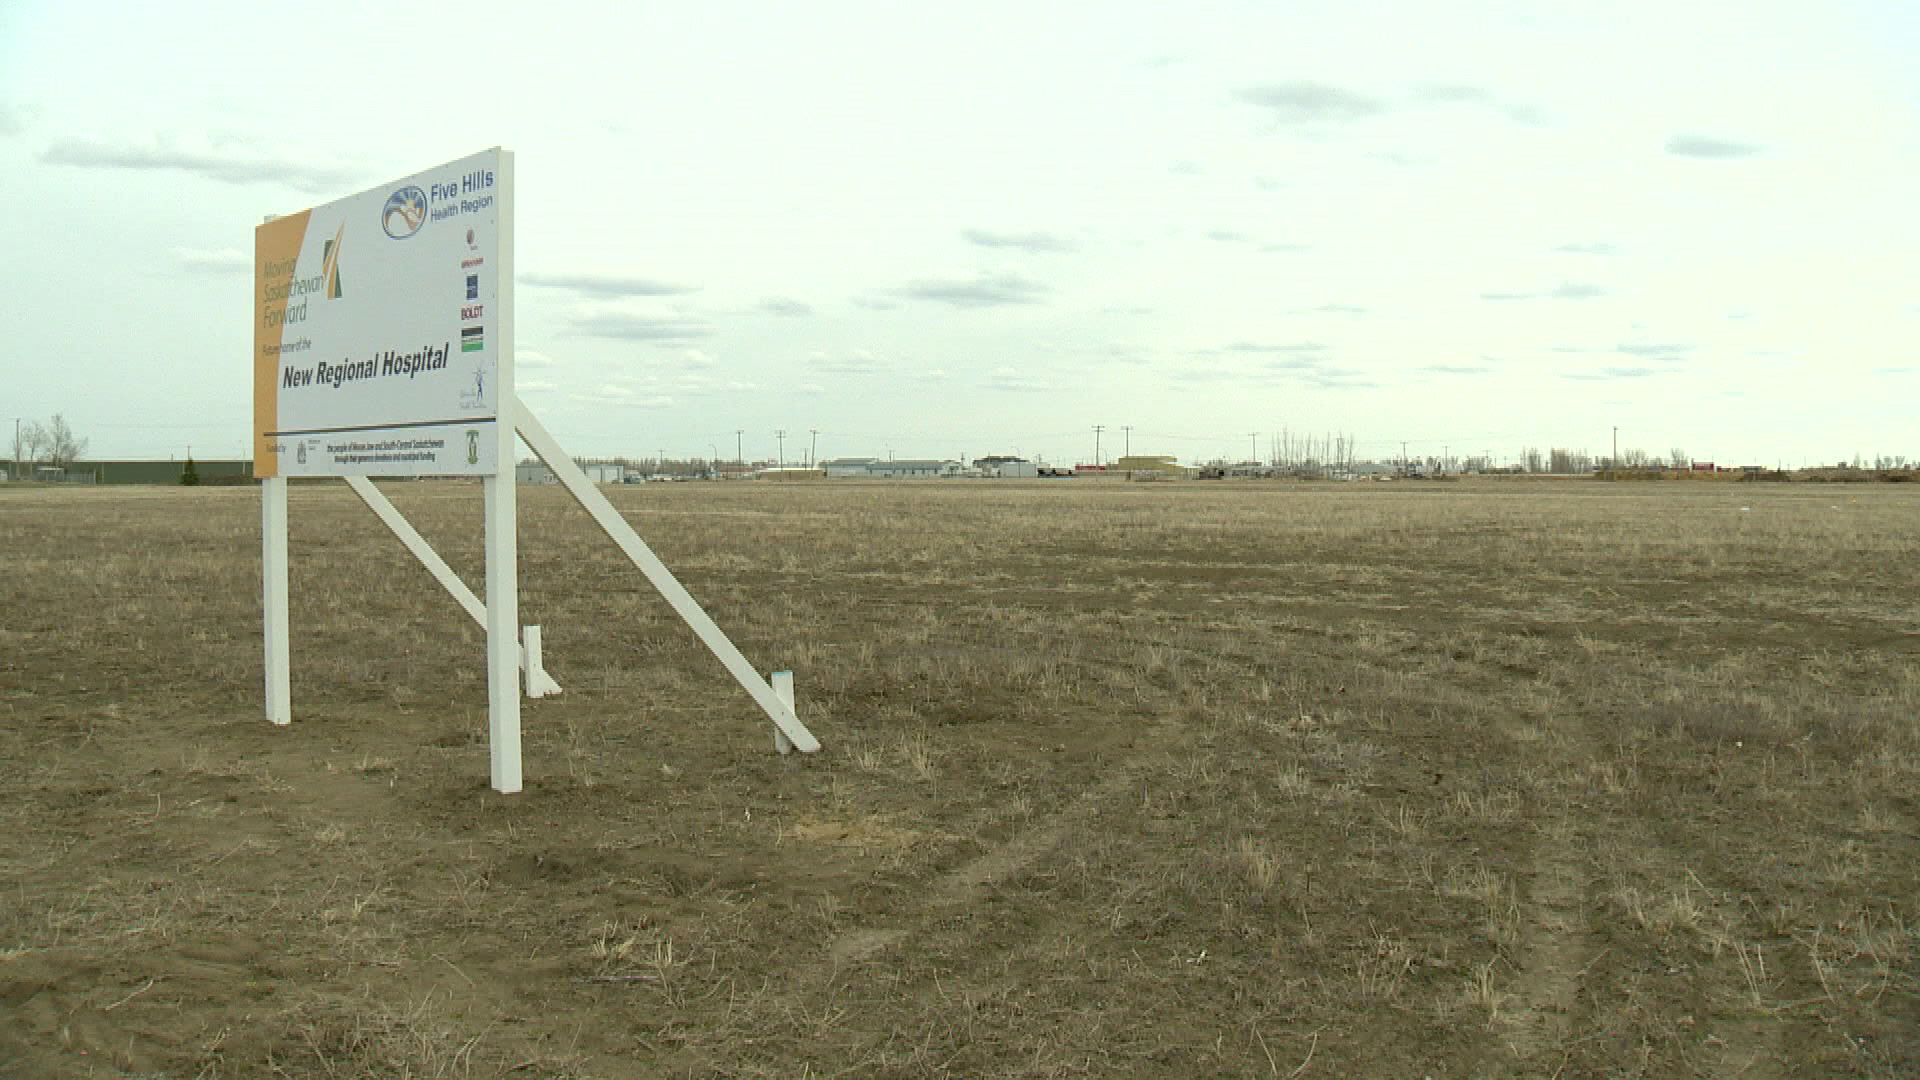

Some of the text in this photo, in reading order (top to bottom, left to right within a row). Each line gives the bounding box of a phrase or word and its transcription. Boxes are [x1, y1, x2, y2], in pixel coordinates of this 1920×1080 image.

[431, 168, 494, 204] Five Hills
[430, 195, 493, 222] Health Region
[263, 275, 324, 304] Saskatchewan
[263, 296, 308, 329] Forward
[283, 342, 450, 389] New Regional Hospital
